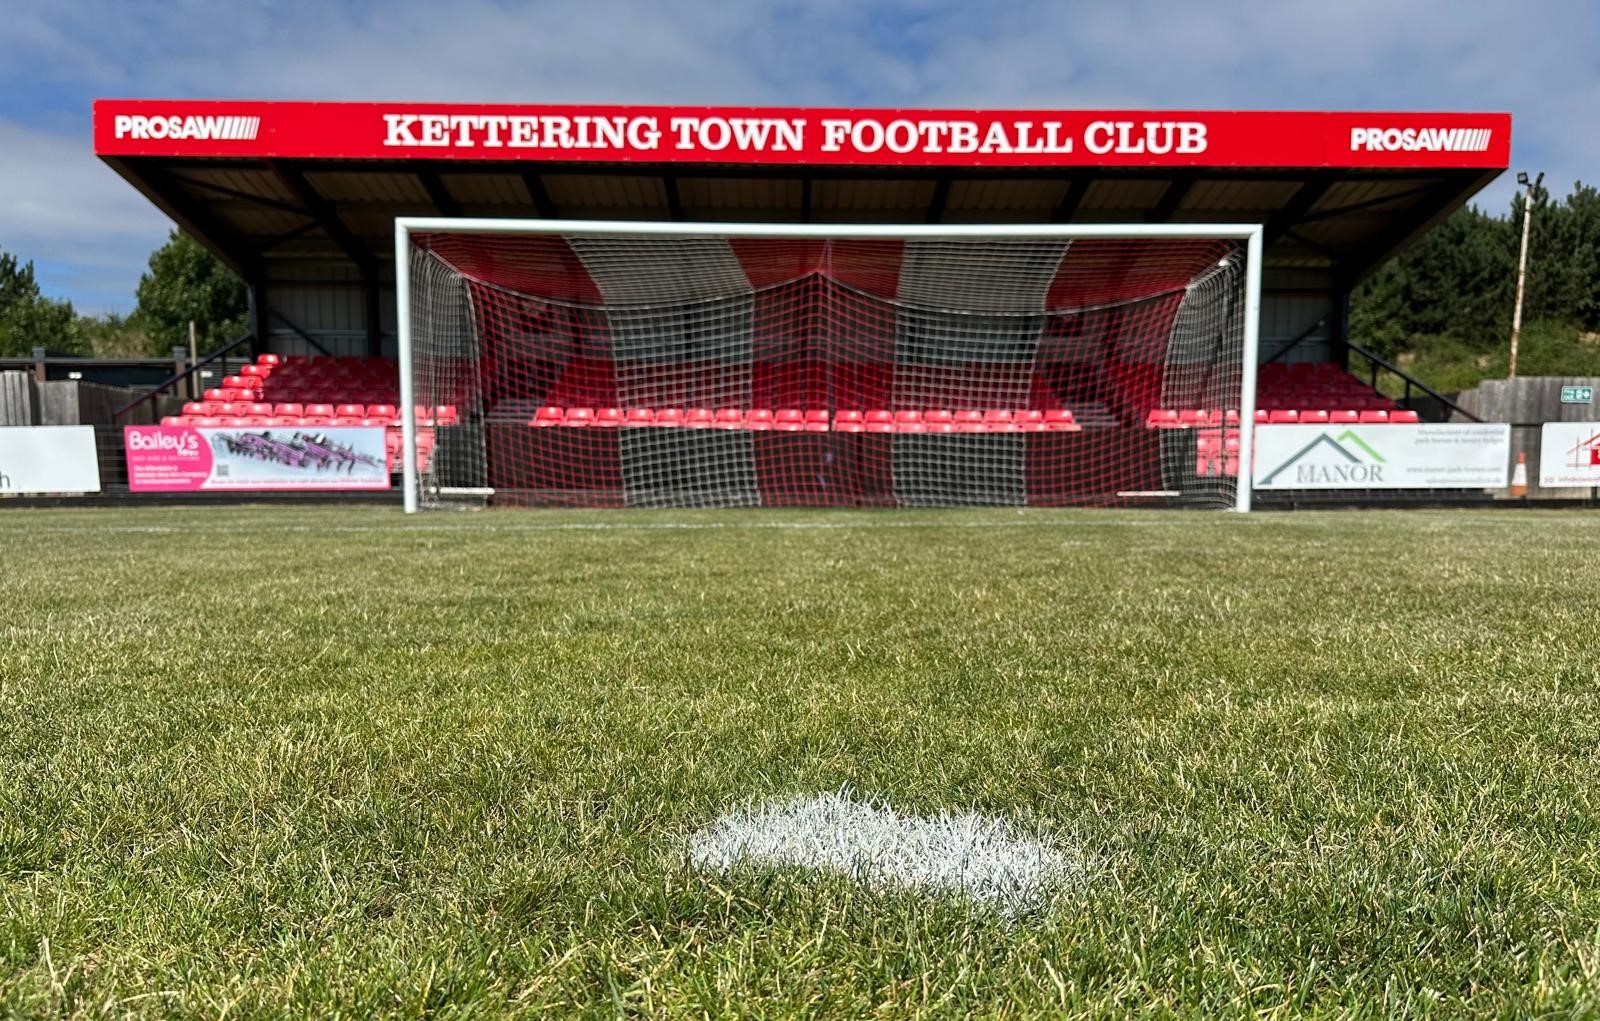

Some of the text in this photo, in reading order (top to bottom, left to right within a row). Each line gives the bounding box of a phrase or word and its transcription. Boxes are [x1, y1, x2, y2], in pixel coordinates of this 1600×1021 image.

[115, 115, 226, 140] PROSAW
[383, 114, 1208, 155] KETTERING TOWN FOOTBALL CLUB
[1351, 127, 1458, 152] PROSAW
[129, 430, 199, 454] Bailey's
[1296, 463, 1384, 483] MANOR
